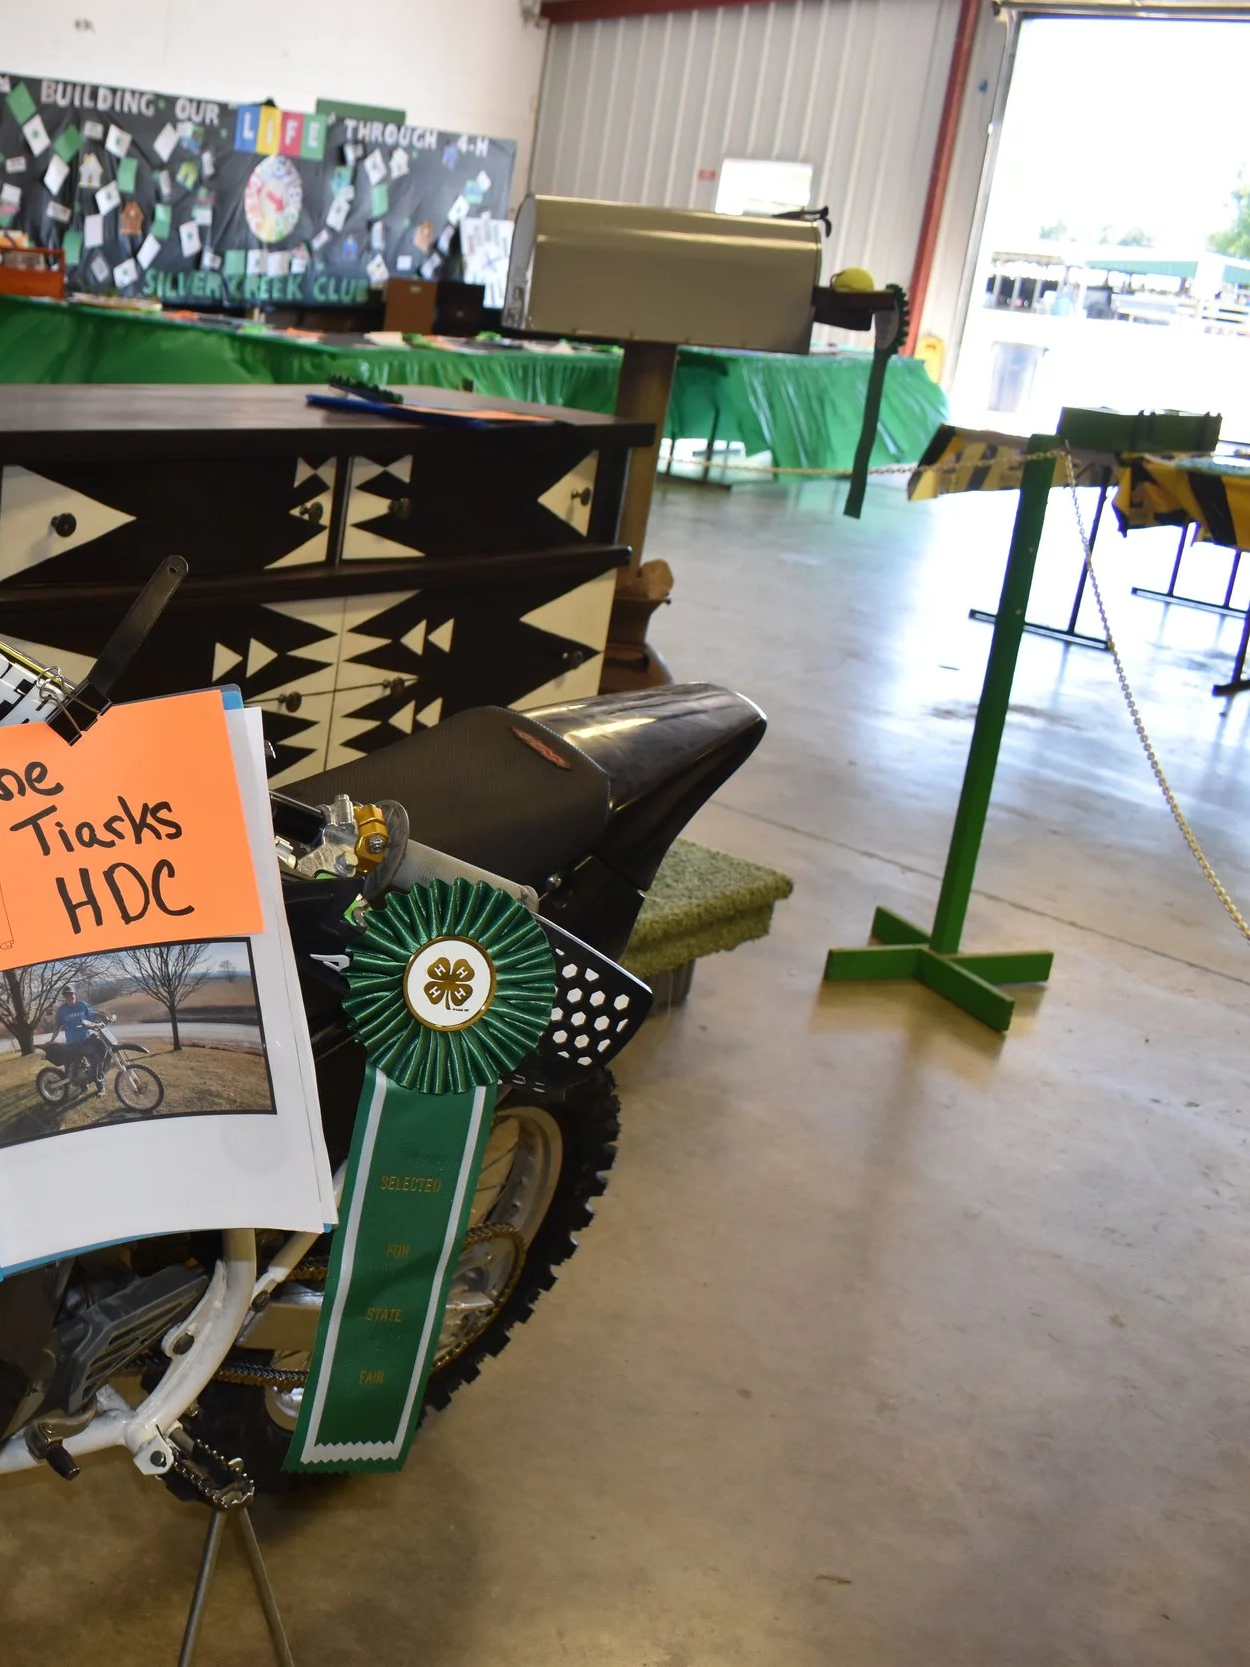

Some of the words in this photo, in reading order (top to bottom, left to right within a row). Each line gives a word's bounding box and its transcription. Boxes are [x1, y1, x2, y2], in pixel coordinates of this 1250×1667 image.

[40, 79, 155, 116] BUILDING
[174, 97, 220, 126] OUR
[344, 119, 438, 150] THROUGH
[143, 268, 222, 298] SILVER
[9, 796, 182, 856] Tiarks
[55, 858, 195, 934] HDC
[380, 1175, 442, 1193] SELECTED
[366, 1307, 403, 1323] STATE
[358, 1370, 385, 1386] FAIR
